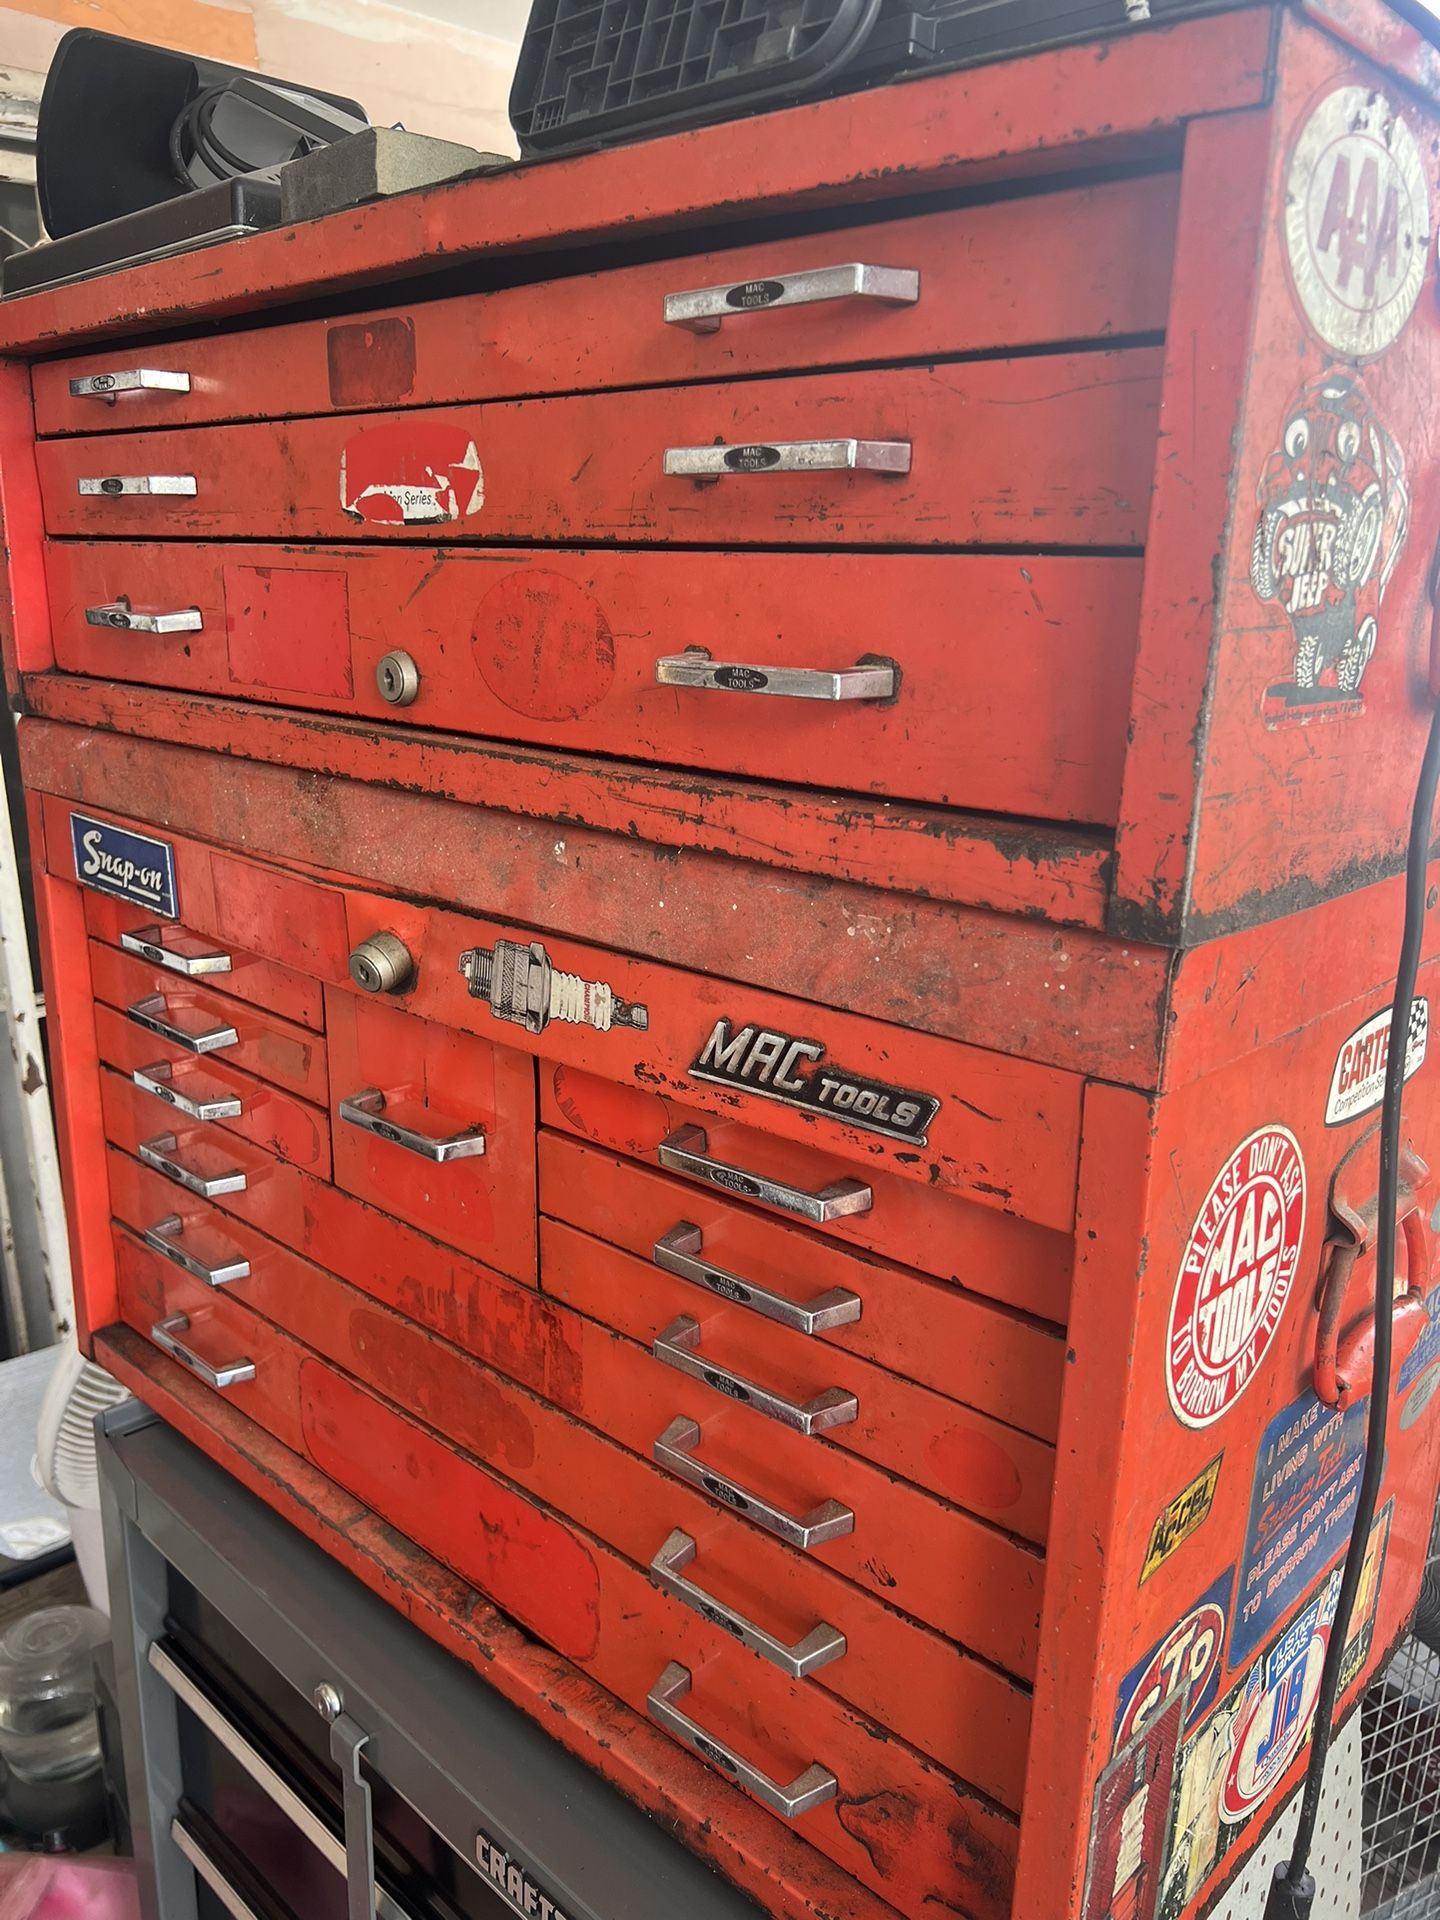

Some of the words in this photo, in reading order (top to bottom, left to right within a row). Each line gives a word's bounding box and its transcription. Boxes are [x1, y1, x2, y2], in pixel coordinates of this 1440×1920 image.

[741, 293, 770, 306] TOOLS
[745, 282, 765, 295] MAC
[738, 457, 767, 467] TOOLS
[742, 447, 762, 457] MAC
[1286, 572, 1329, 614] JEEP
[727, 678, 755, 689] TOOLS
[731, 668, 750, 678] MAC
[82, 829, 164, 895] Snap-on
[698, 1020, 823, 1091] MAC
[818, 1077, 921, 1127] TOOLS
[1337, 1023, 1392, 1095] CARTE
[724, 1178, 749, 1193] TOOLS
[727, 1172, 744, 1184] MAC
[1185, 1156, 1243, 1274] PLEASE
[1248, 1135, 1289, 1179] DON'T
[1280, 1154, 1302, 1213] ASK
[1201, 1189, 1281, 1301] MAC
[716, 1282, 740, 1299] TOOLS
[719, 1277, 736, 1290] MAC
[1199, 1252, 1278, 1364] TOOLS
[1260, 1243, 1297, 1335] TOOLS
[1172, 1314, 1194, 1366] TO
[1235, 1337, 1257, 1391] MY
[715, 1381, 739, 1398] TOOLS
[719, 1375, 735, 1388] MAC
[1176, 1356, 1231, 1416] BORROW
[1261, 1443, 1309, 1504] LIVING
[1312, 1411, 1345, 1452] WITH
[1267, 1443, 1275, 1466] I
[1276, 1400, 1320, 1456] MAKE
[1246, 1521, 1299, 1591] PLEASE
[1300, 1480, 1338, 1533] DON'T
[1337, 1454, 1362, 1494] ASK
[1242, 1590, 1262, 1623] TO
[1266, 1524, 1321, 1599] BORROW
[1323, 1486, 1357, 1534] THEM
[1272, 1607, 1318, 1668] JUSTICE
[1275, 1631, 1309, 1679] BROS.
[1131, 1621, 1214, 1736] STP
